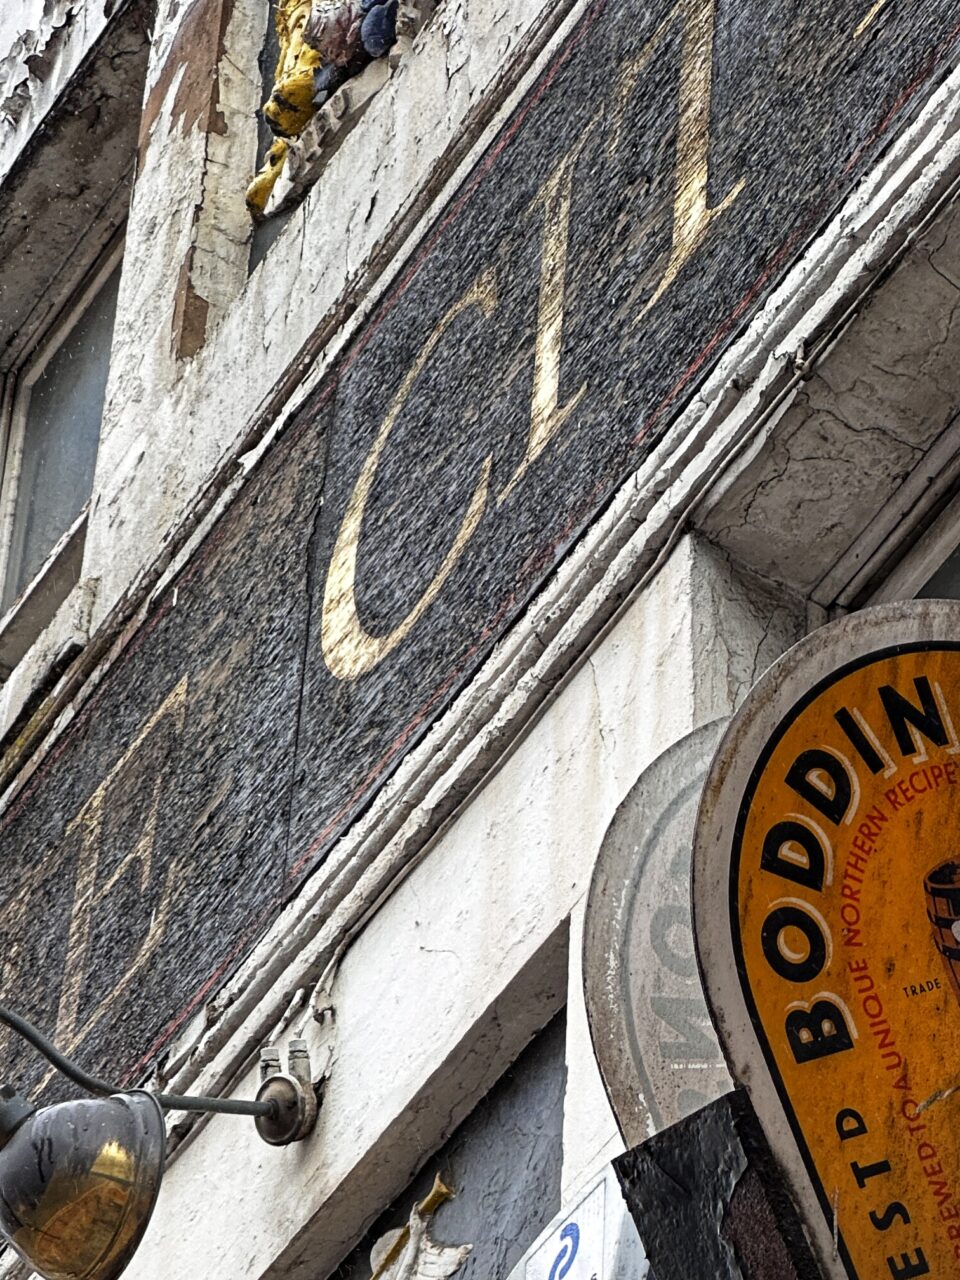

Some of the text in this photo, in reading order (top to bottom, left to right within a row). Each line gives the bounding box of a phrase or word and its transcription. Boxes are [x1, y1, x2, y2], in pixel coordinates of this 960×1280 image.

[320, 0, 890, 682] CIT
[885, 760, 957, 812] RECIPE
[840, 804, 890, 947] NORTHERN
[903, 977, 942, 999] TRADE
[849, 958, 902, 1071] UNIQUE
[892, 1073, 912, 1091] A
[900, 1100, 927, 1137] TO
